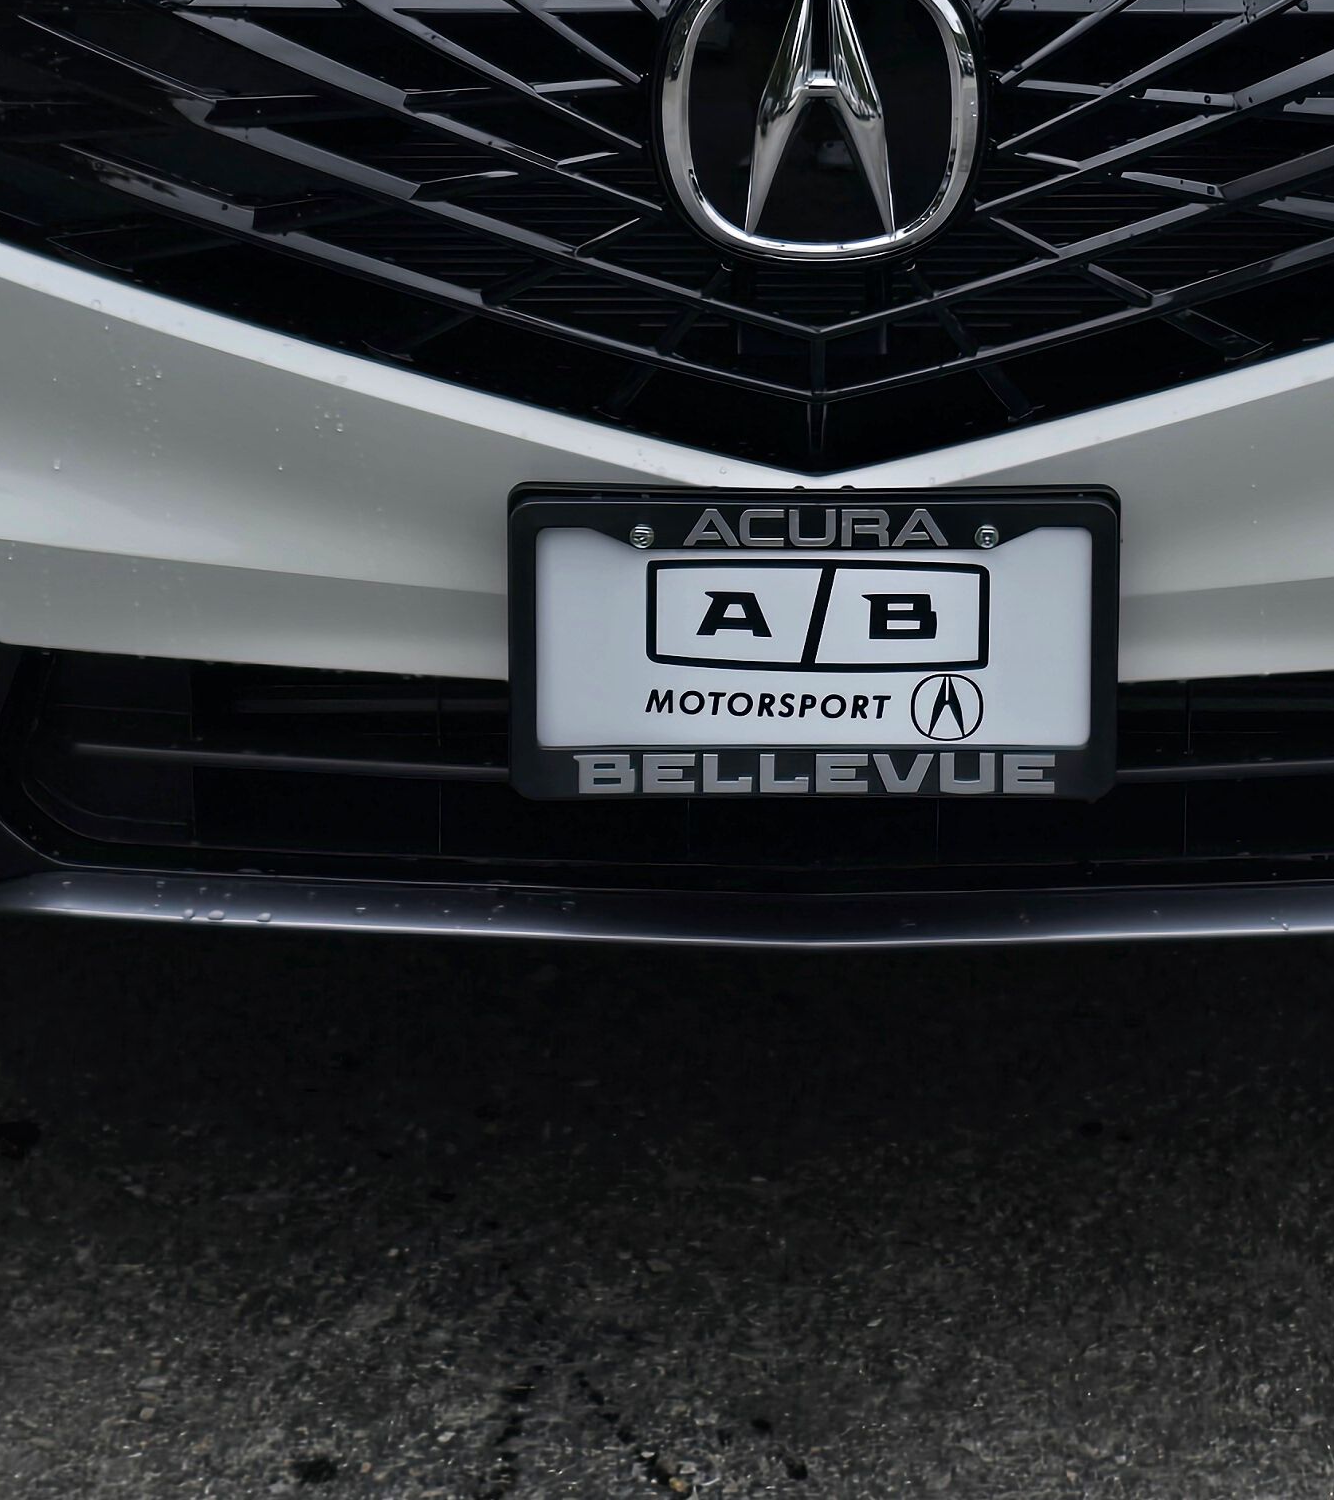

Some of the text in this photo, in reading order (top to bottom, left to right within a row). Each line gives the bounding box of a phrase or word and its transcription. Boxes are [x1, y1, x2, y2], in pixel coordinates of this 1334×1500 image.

[682, 508, 949, 548] ACURA
[695, 590, 939, 640] A B
[644, 688, 893, 720] MOTORSPORT
[572, 752, 1057, 795] BELLEVUE
